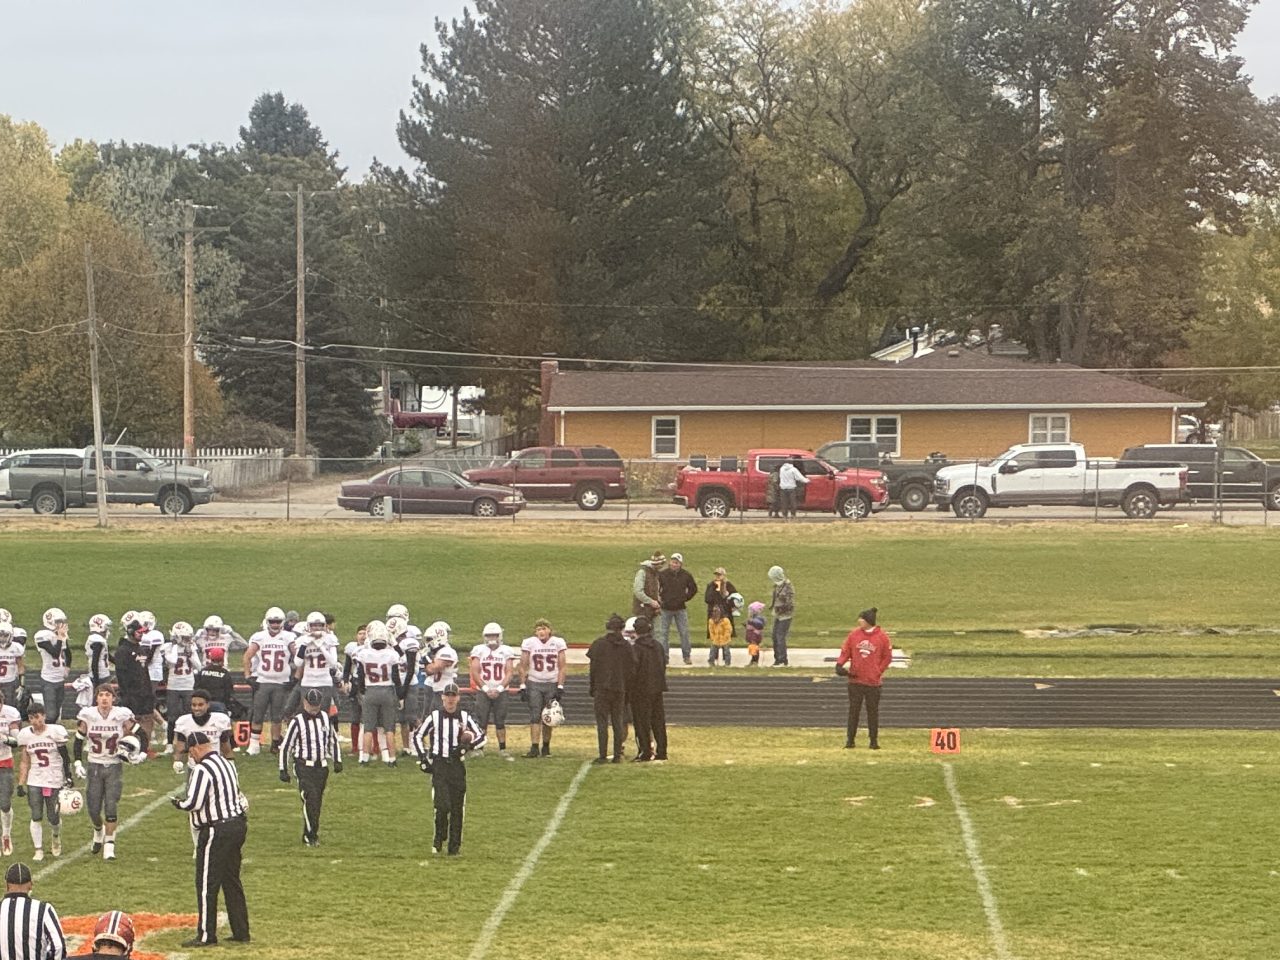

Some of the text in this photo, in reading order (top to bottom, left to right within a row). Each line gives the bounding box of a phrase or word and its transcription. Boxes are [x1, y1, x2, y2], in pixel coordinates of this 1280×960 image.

[261, 650, 286, 672] 56
[532, 654, 558, 672] 65
[365, 663, 390, 683] 51
[482, 662, 503, 681] 50
[88, 733, 119, 755] 54
[935, 731, 956, 750] 40
[34, 748, 50, 767] 5
